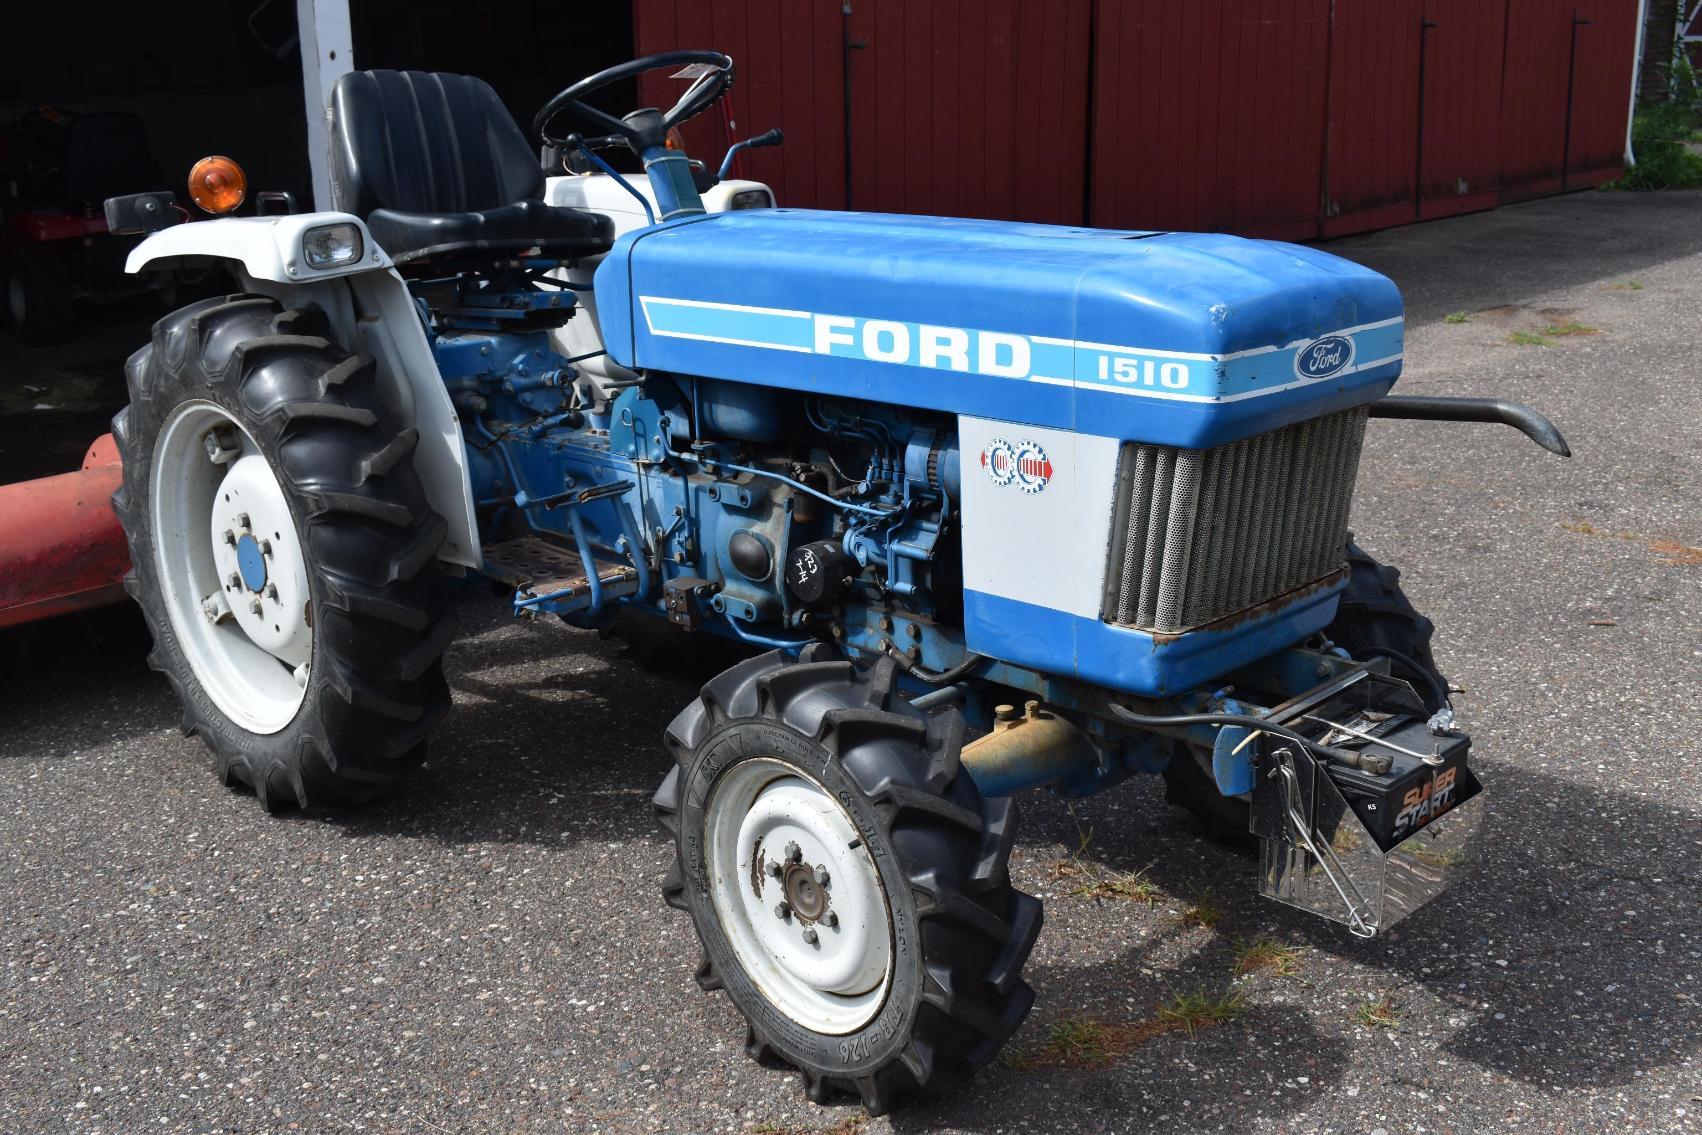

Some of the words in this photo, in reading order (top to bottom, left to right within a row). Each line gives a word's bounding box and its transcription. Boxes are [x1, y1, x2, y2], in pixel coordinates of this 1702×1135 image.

[814, 313, 1031, 379] FORD
[1098, 355, 1189, 389] 1510
[1310, 342, 1342, 371] Ford
[1392, 783, 1455, 838] START
[838, 996, 904, 1065] TR-126
